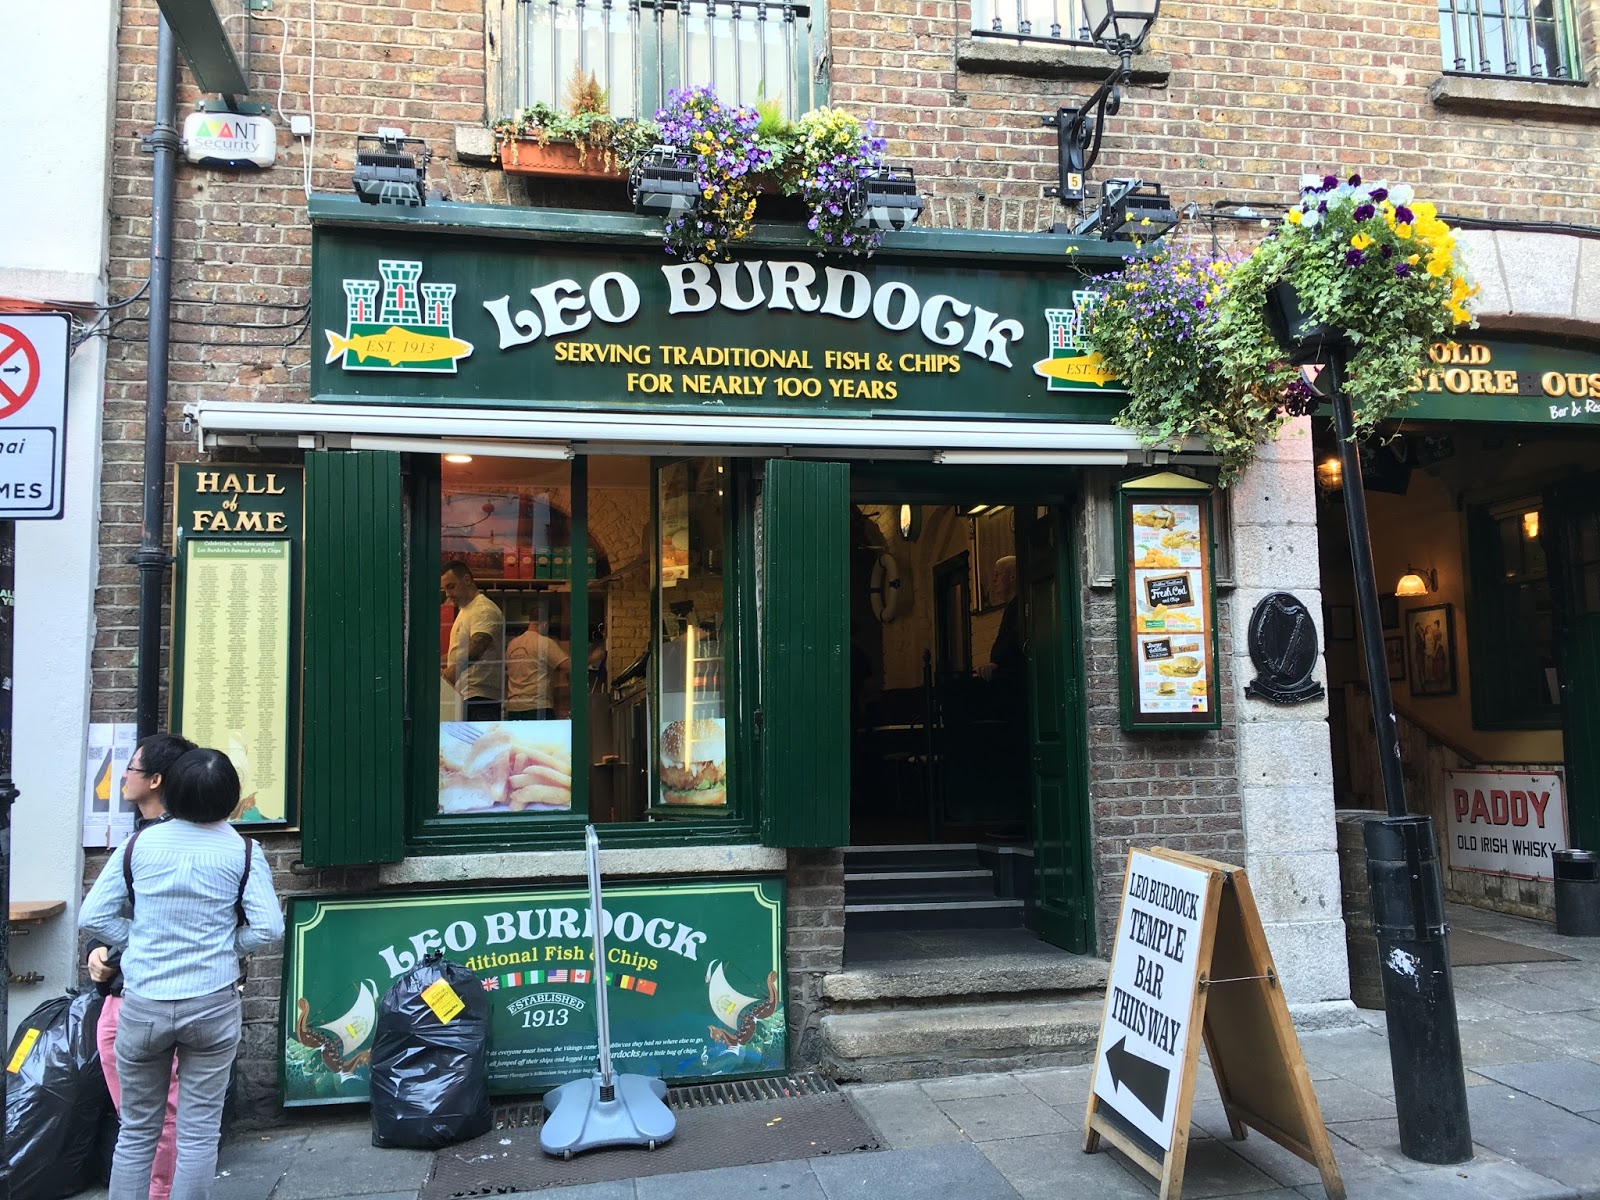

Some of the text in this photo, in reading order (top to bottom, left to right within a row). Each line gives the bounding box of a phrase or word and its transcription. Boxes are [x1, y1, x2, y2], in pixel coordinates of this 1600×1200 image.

[194, 137, 261, 153] Security
[1071, 176, 1079, 187] 5
[483, 260, 1025, 369] LEO BURDOCK
[366, 340, 436, 355] EST. 1913
[554, 341, 962, 374] SERVING TRADITIONAL FISH & CHIPS
[1429, 342, 1492, 365] OLD
[1066, 363, 1091, 375] EST.
[627, 373, 898, 401] FOR NEARLY 100 YEARS
[1548, 405, 1569, 420] Bar
[1571, 400, 1582, 417] &
[196, 472, 285, 495] HALL
[222, 493, 239, 512] of
[192, 510, 288, 532] FAME
[1150, 584, 1188, 600] Fresh Cod
[1453, 788, 1551, 829] PADDY
[1457, 835, 1477, 851] OLD
[1481, 837, 1508, 854] IRISH
[1129, 872, 1200, 922] LEO BURDOCK
[378, 907, 708, 979] LEO BURDOCK
[1129, 907, 1188, 964] TEMPLE
[464, 947, 538, 973] ditional
[544, 945, 585, 962] Fish
[607, 948, 659, 972] Chips
[1133, 954, 1165, 1001] BAR
[507, 993, 585, 1014] ESTABLISHED
[521, 1008, 569, 1029] 1913
[1147, 1006, 1182, 1058] WAY
[495, 1059, 517, 1068] jumped
[517, 1058, 527, 1066] off
[608, 1049, 640, 1059] urdocks
[639, 1050, 649, 1058] for
[677, 1048, 684, 1056] of
